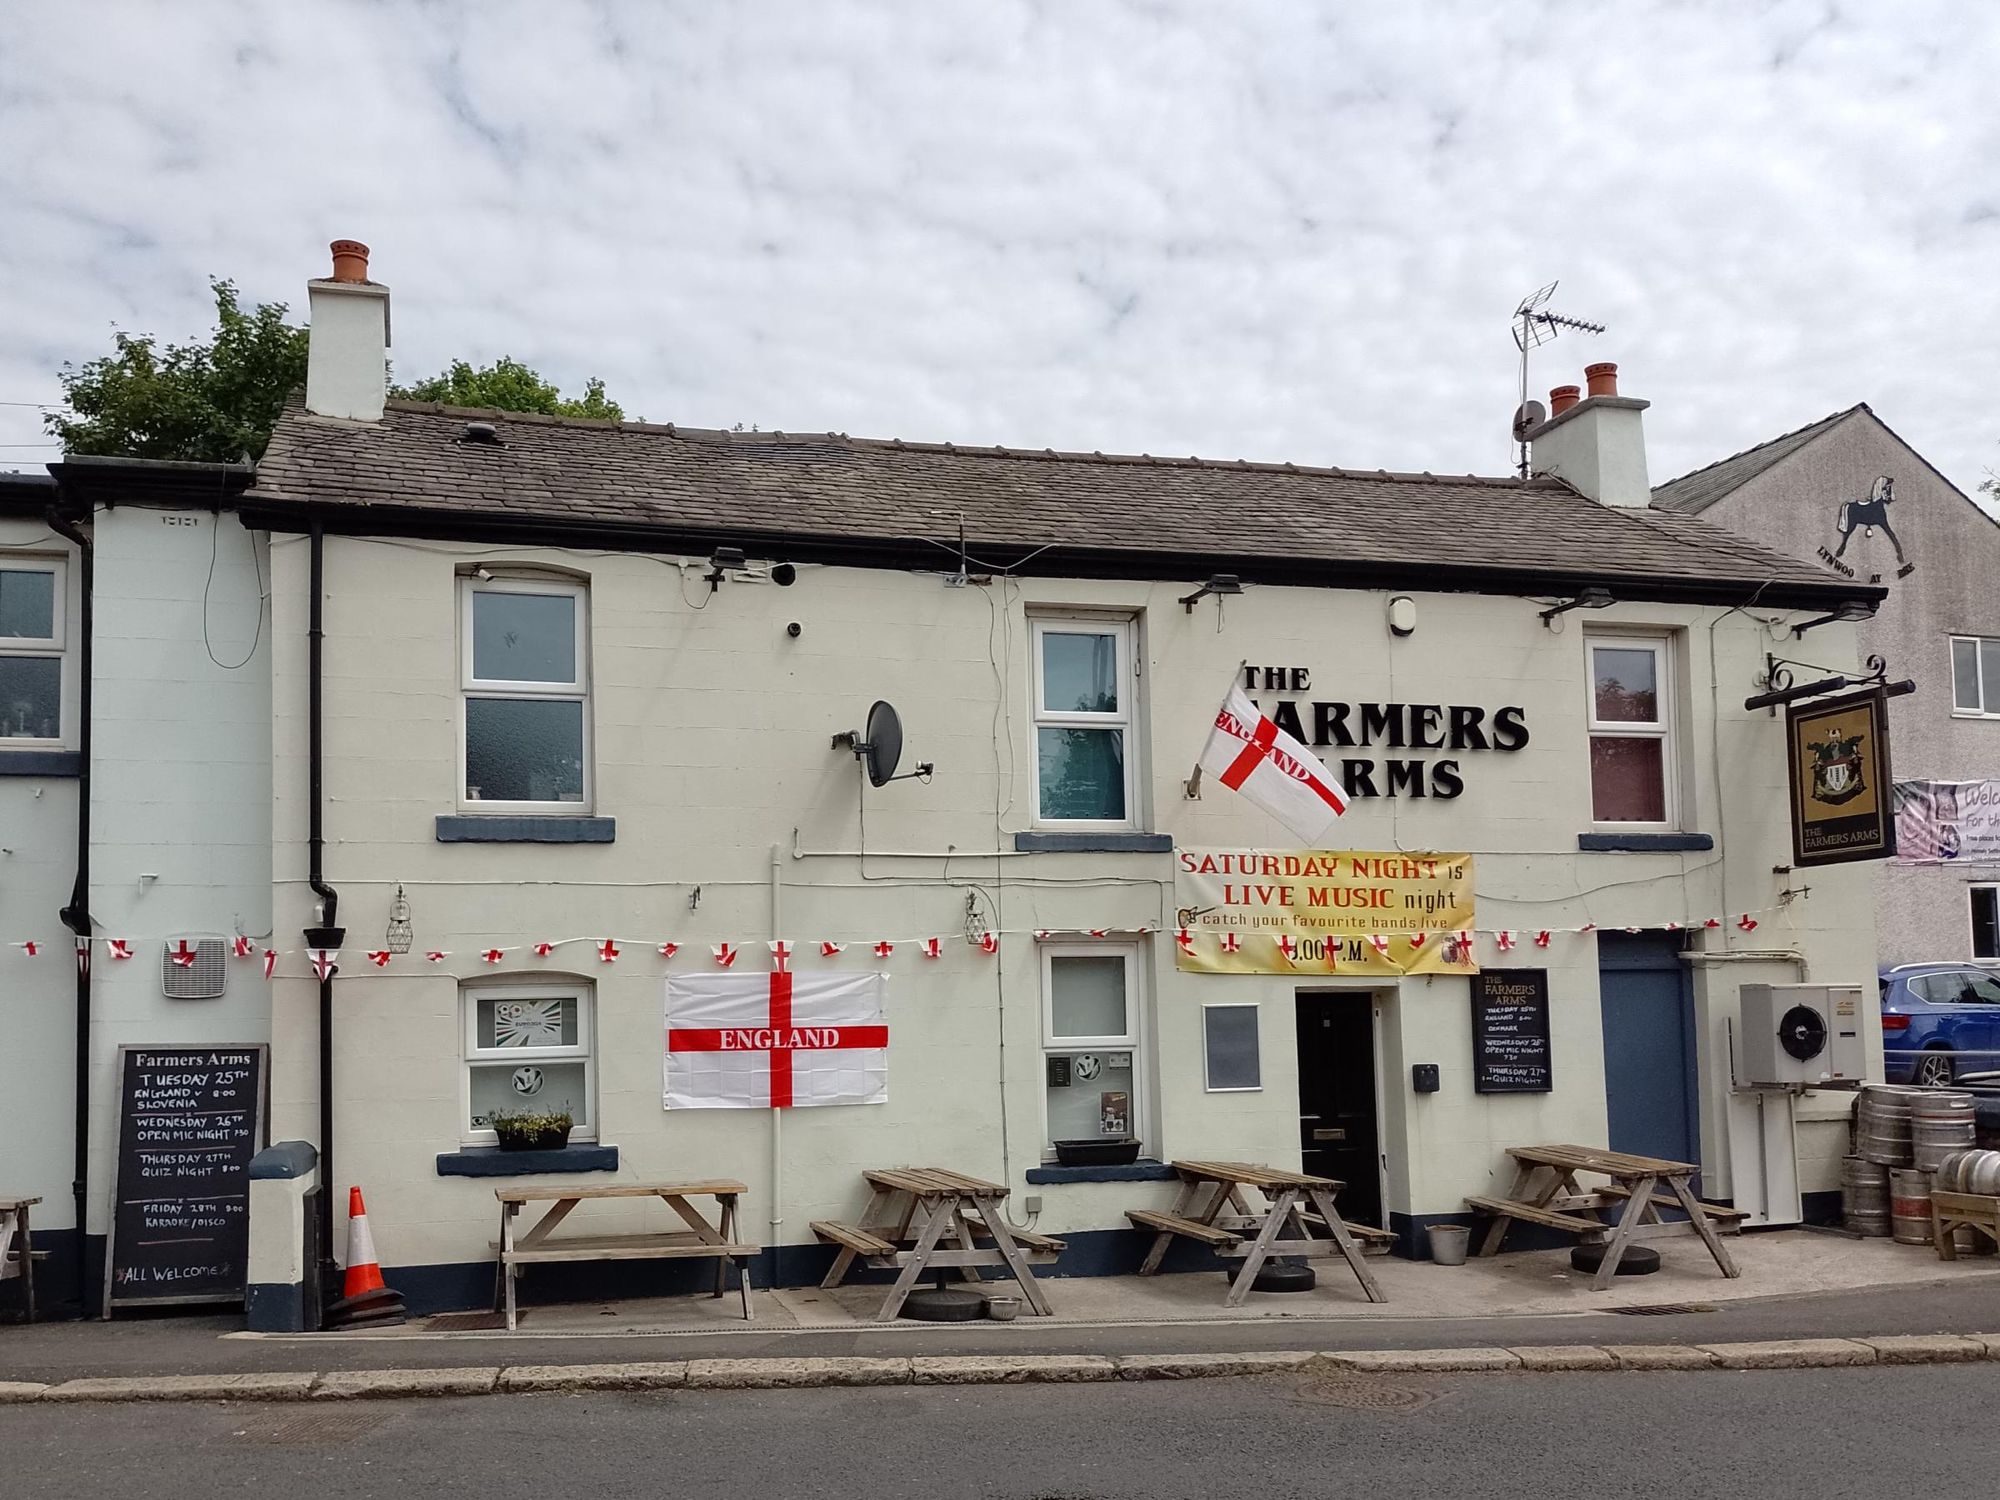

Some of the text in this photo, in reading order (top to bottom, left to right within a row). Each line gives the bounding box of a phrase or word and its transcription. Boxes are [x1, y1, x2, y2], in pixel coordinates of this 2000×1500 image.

[1244, 666, 1312, 691] THE
[1250, 700, 1530, 751] ARMERS
[1318, 758, 1464, 799] RMS
[1965, 785, 2000, 807] Welc
[1966, 813, 1984, 827] For
[1804, 827, 1822, 837] THE
[1805, 829, 1879, 848] FARMERS ARMS
[1181, 853, 1464, 880] SATURDAY NIGHT is
[1223, 884, 1457, 914] LIVE MUSIC night
[1202, 913, 1448, 928] catch your favourite bands live
[1292, 939, 1368, 962] .00 .M.
[1485, 984, 1536, 995] FARMERS
[1496, 995, 1527, 1005] ARMS
[719, 1028, 840, 1050] ENGLAND
[1485, 1046, 1505, 1054] OPEN
[136, 1052, 251, 1067] Farmers Arms
[139, 1074, 209, 1087] TUESDAY
[134, 1088, 191, 1099] ENGLAND
[137, 1099, 198, 1110] SLOVENIA
[136, 1116, 207, 1128] WEDNESDAY
[137, 1130, 170, 1141] OPEN
[173, 1130, 194, 1141] MIC
[196, 1129, 230, 1141] NIGHT
[140, 1154, 202, 1165] THURSDAY
[141, 1167, 173, 1177] QUIZ
[177, 1165, 214, 1177] NIGHT
[143, 1204, 183, 1215] FRIDAY
[123, 1265, 218, 1285] ALL WELCOME
